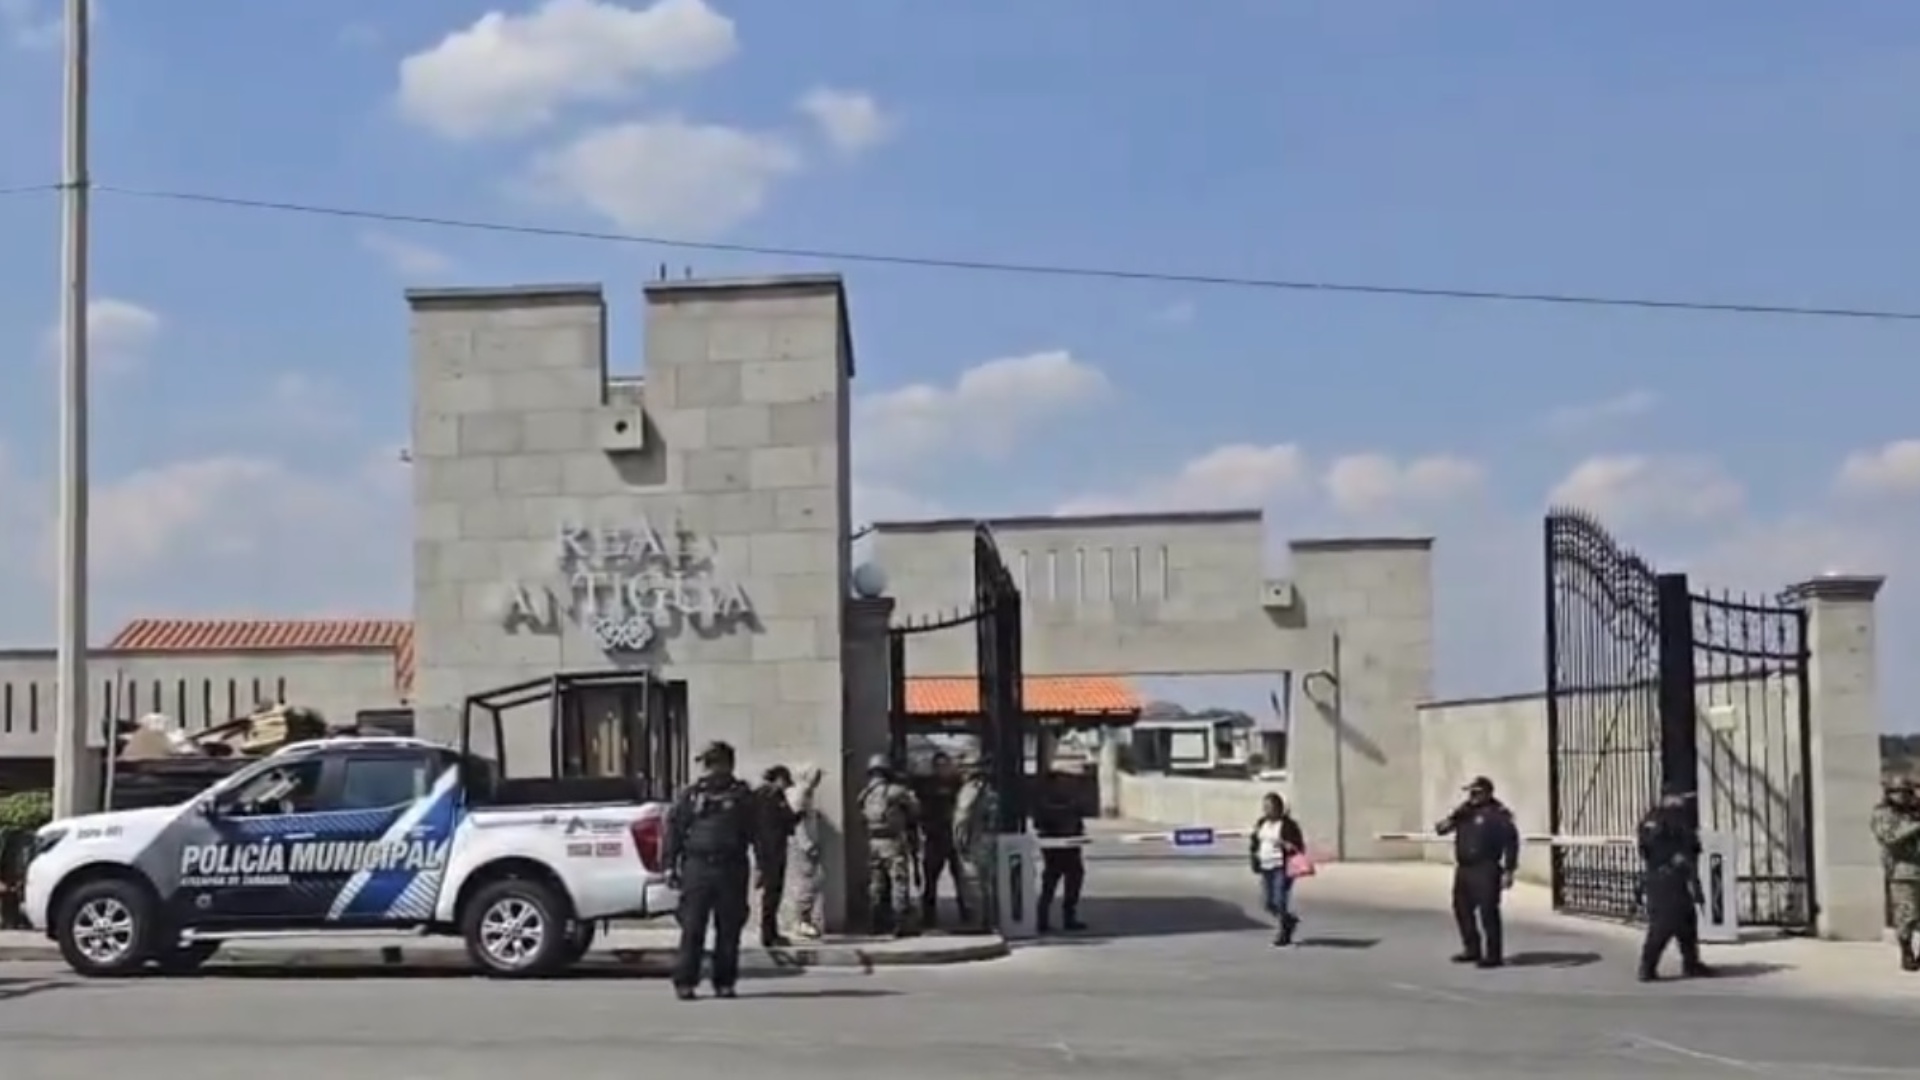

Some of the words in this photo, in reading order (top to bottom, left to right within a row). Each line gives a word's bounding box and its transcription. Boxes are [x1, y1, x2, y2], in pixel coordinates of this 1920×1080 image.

[558, 522, 716, 564] REAL
[504, 571, 760, 630] ANTIGUA
[181, 837, 284, 874] POLICÍA
[289, 840, 442, 872] MUNICIPAL
